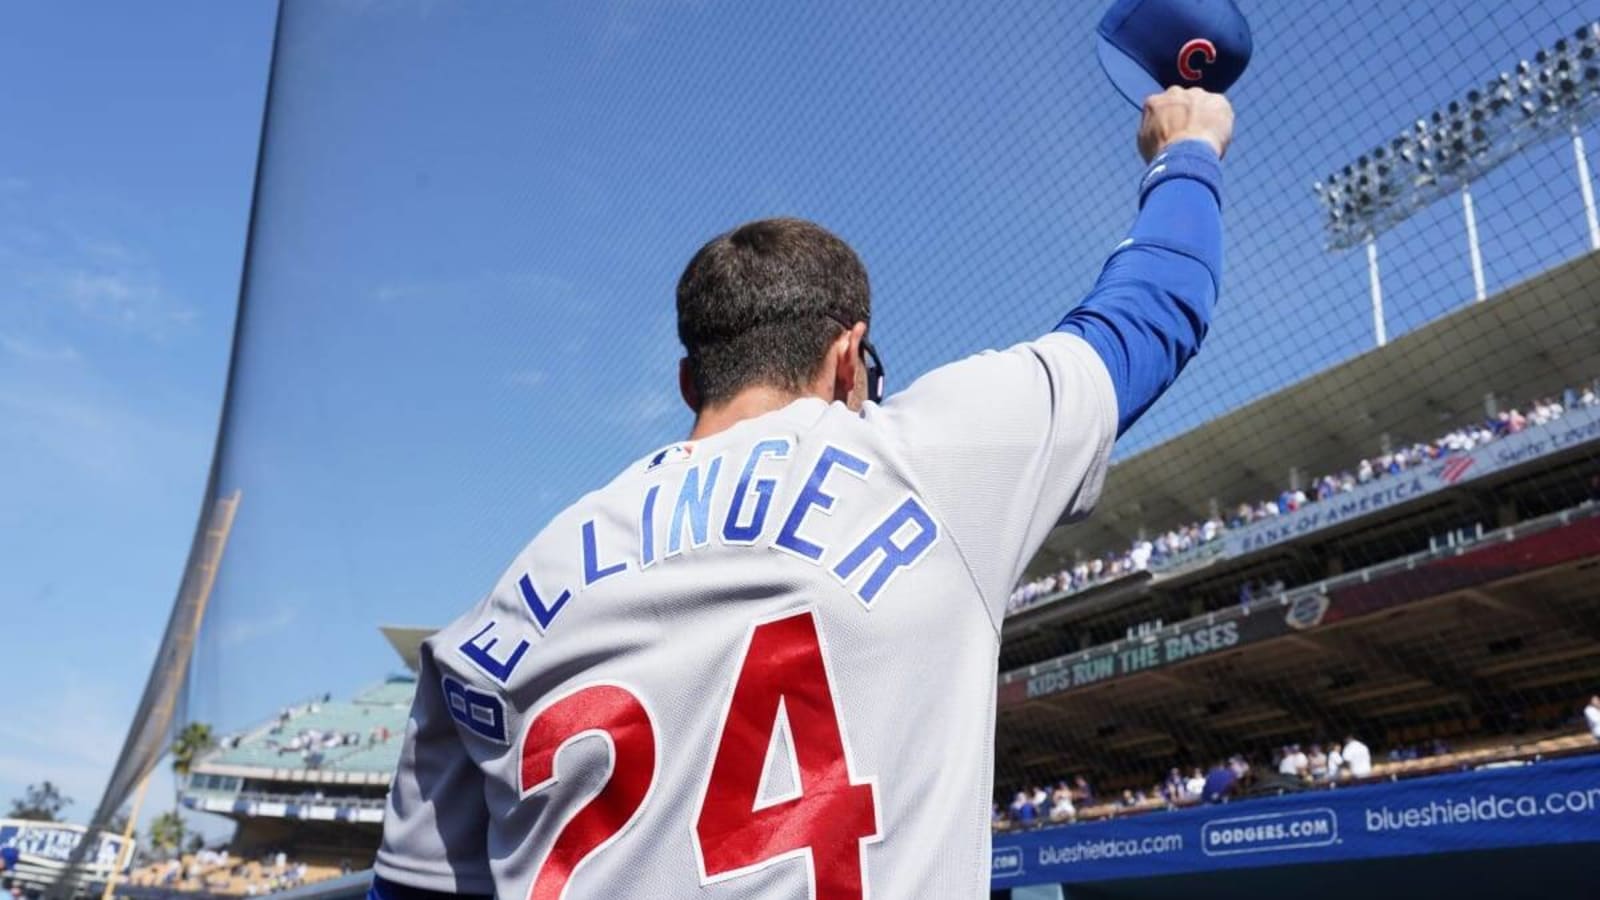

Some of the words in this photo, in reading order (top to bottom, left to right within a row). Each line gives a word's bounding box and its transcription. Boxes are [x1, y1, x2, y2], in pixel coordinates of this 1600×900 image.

[1177, 38, 1216, 80] C
[1241, 527, 1291, 549] BANK
[1295, 513, 1320, 532] OF
[1326, 478, 1424, 519] AMERICA
[441, 436, 941, 745] BELLINGER
[1027, 667, 1070, 699] KIDS
[1072, 655, 1115, 686] RUN
[1119, 645, 1159, 673] THE
[1164, 621, 1240, 662] BASES
[519, 606, 884, 900] 24
[1038, 834, 1183, 866] blueshieldca.com
[1209, 819, 1329, 847] DODGERS.COM
